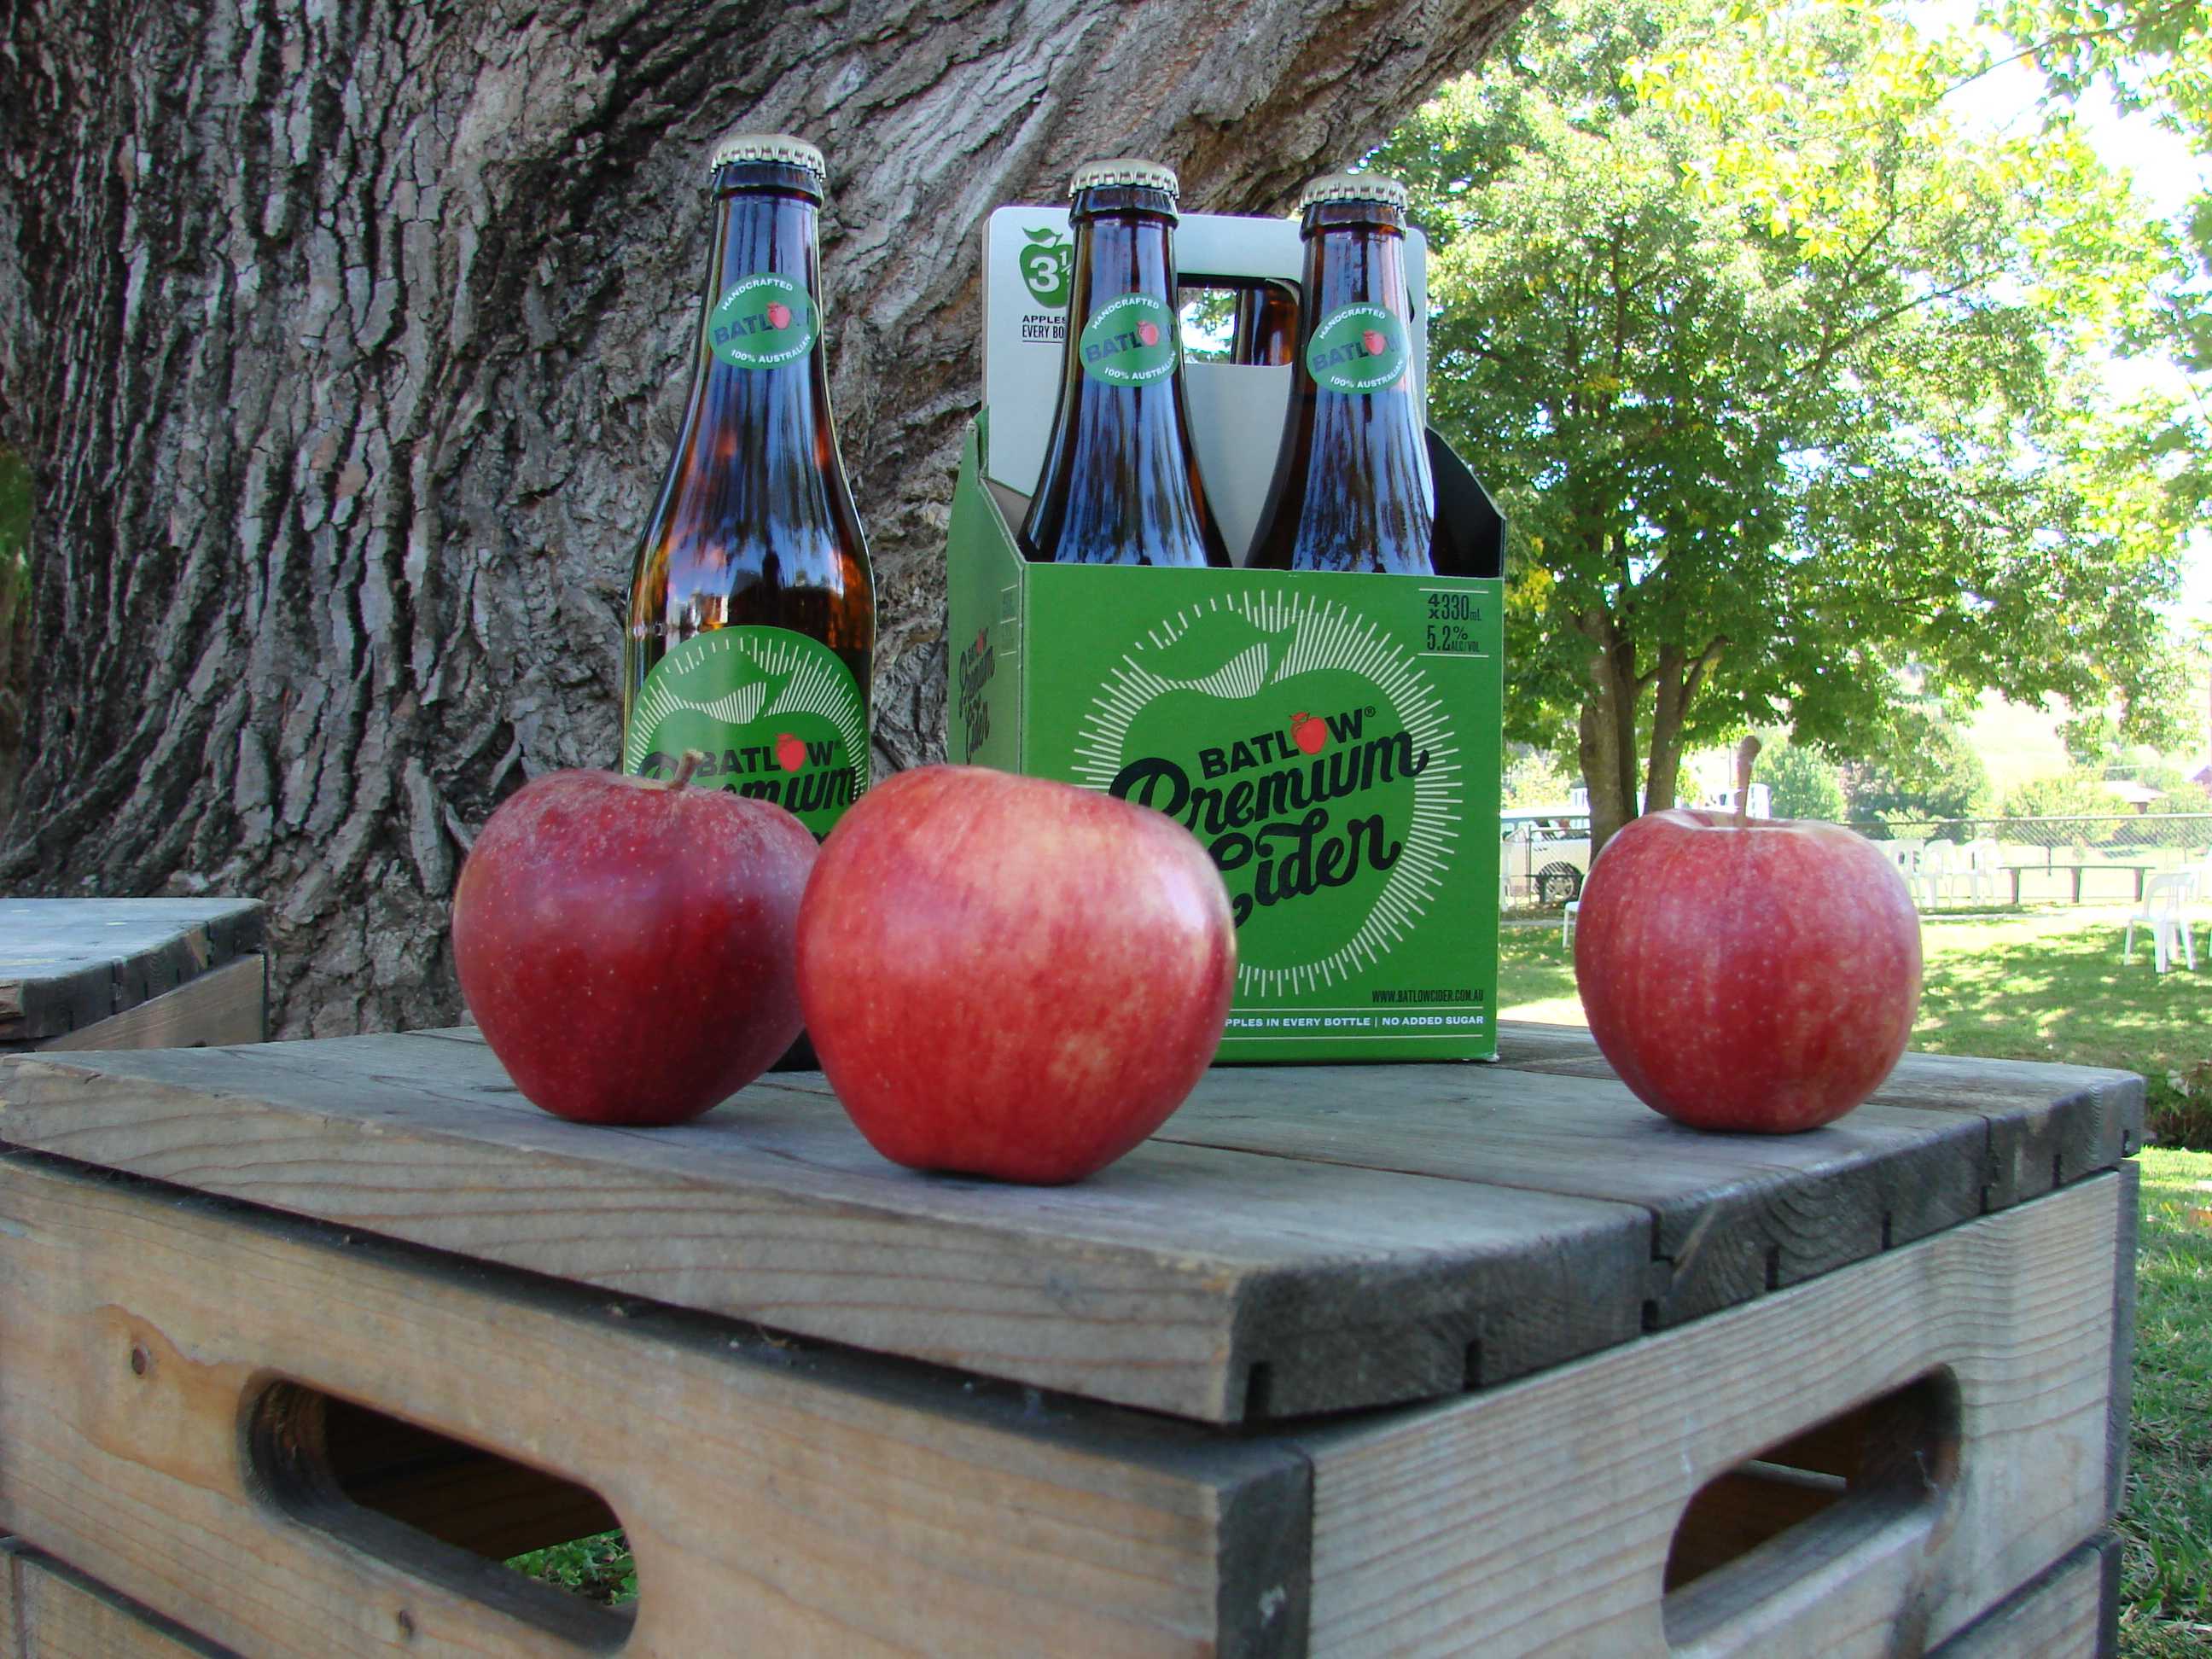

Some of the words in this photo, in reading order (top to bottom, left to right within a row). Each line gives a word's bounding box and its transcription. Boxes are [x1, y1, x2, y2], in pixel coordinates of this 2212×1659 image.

[722, 277, 793, 311] HANDCRAFTED
[1092, 297, 1160, 329] HANDCRAFTED
[1319, 307, 1386, 339] HANDCRAFTED
[1022, 324, 1051, 339] EVERY
[731, 349, 755, 363] 100%
[758, 334, 811, 364] AUSTRALIAN
[1104, 367, 1129, 380] 100%
[1132, 350, 1176, 381] AUSTRALIAN
[1330, 375, 1354, 388] 100%
[1357, 359, 1403, 388] AUSTRALIAN
[1372, 989, 1483, 1003] WWW.BATLOWCIDER.COM.AU
[1224, 1018, 1263, 1027] PPLES
[1266, 1018, 1279, 1027] IN
[1283, 1017, 1321, 1027] EVERY
[1324, 1017, 1371, 1027] BOTTLE
[1382, 1016, 1400, 1026] NO
[1401, 1016, 1442, 1025] ADDED
[1445, 1016, 1484, 1024] SUGAR
